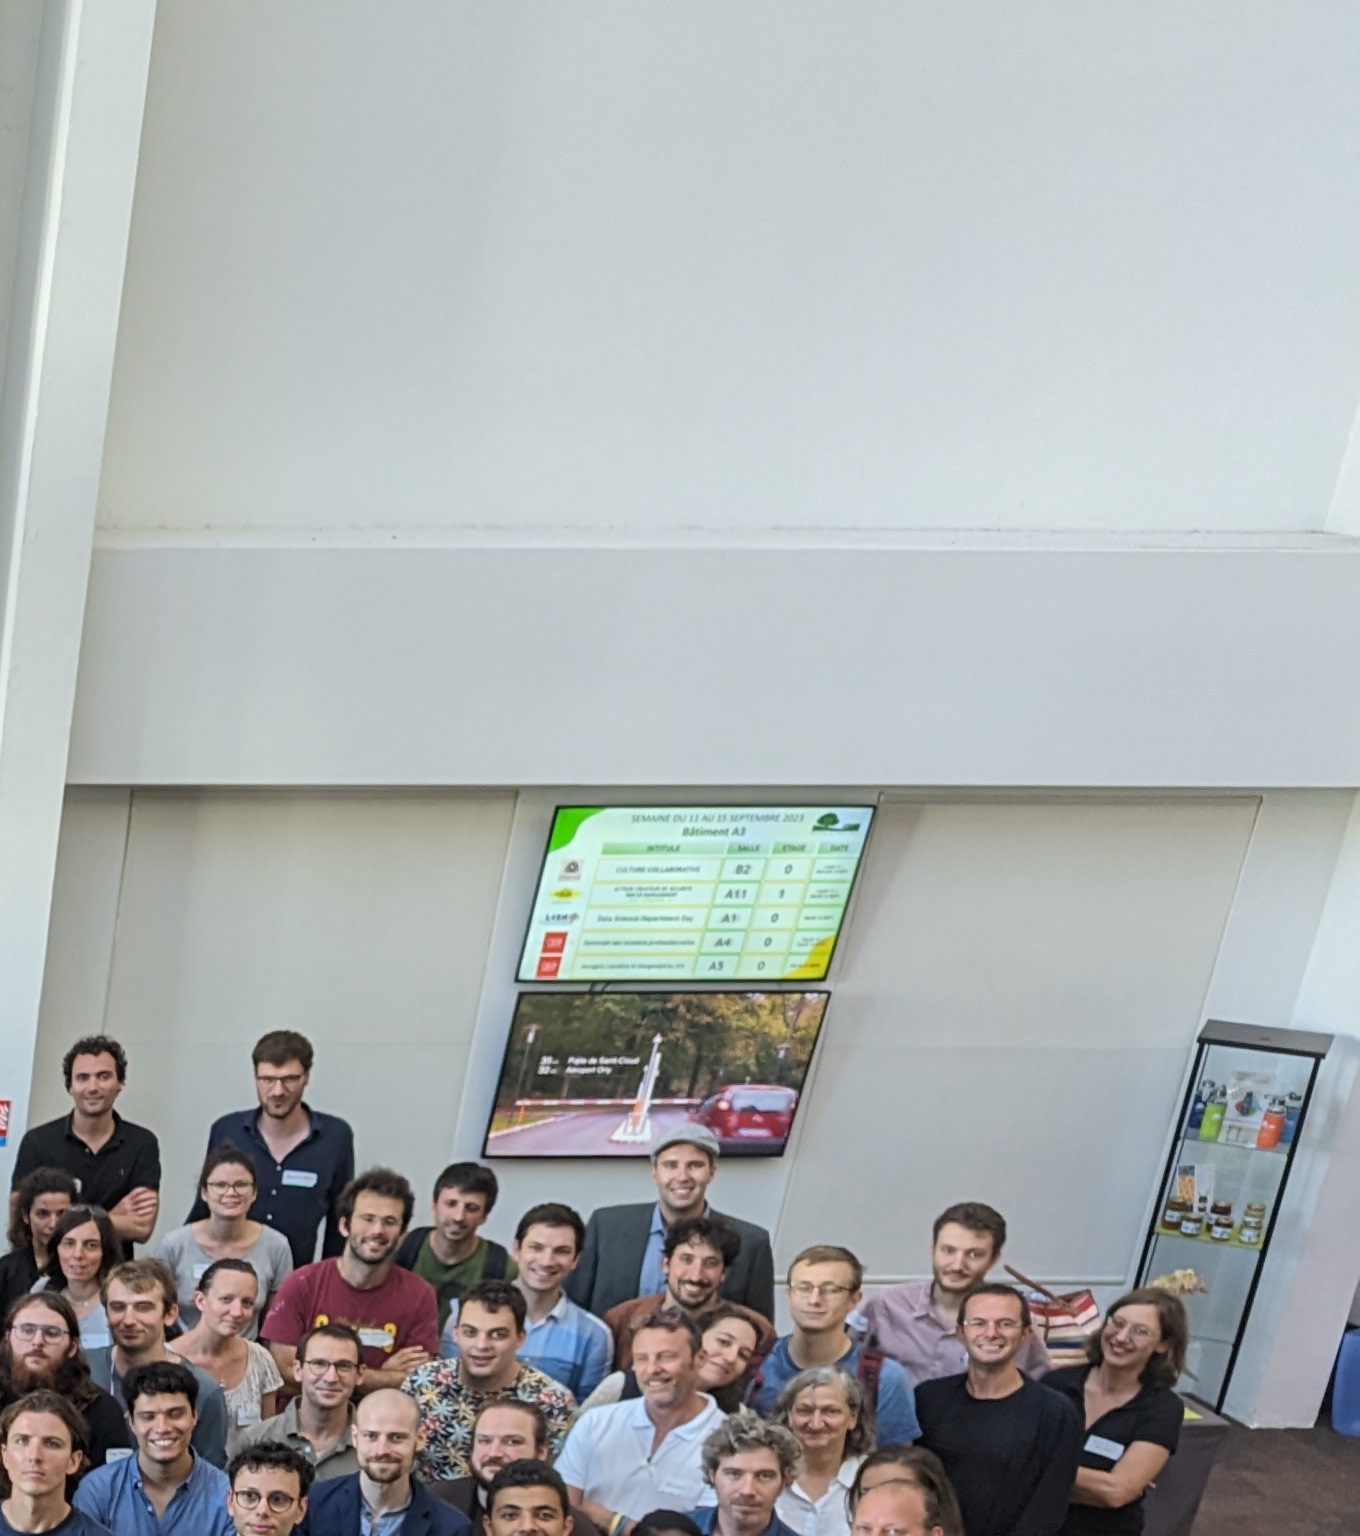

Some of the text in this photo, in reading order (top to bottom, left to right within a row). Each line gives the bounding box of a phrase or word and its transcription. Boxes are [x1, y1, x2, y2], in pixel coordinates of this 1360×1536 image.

[631, 814, 670, 823] SEMAINE
[673, 814, 687, 823] DU
[689, 814, 699, 823] 11
[700, 814, 715, 823] AU
[729, 813, 781, 823] SEPTEMBRE
[782, 813, 805, 823] 2023
[682, 827, 747, 837] Bâtiment A3
[737, 844, 761, 852] SALLE
